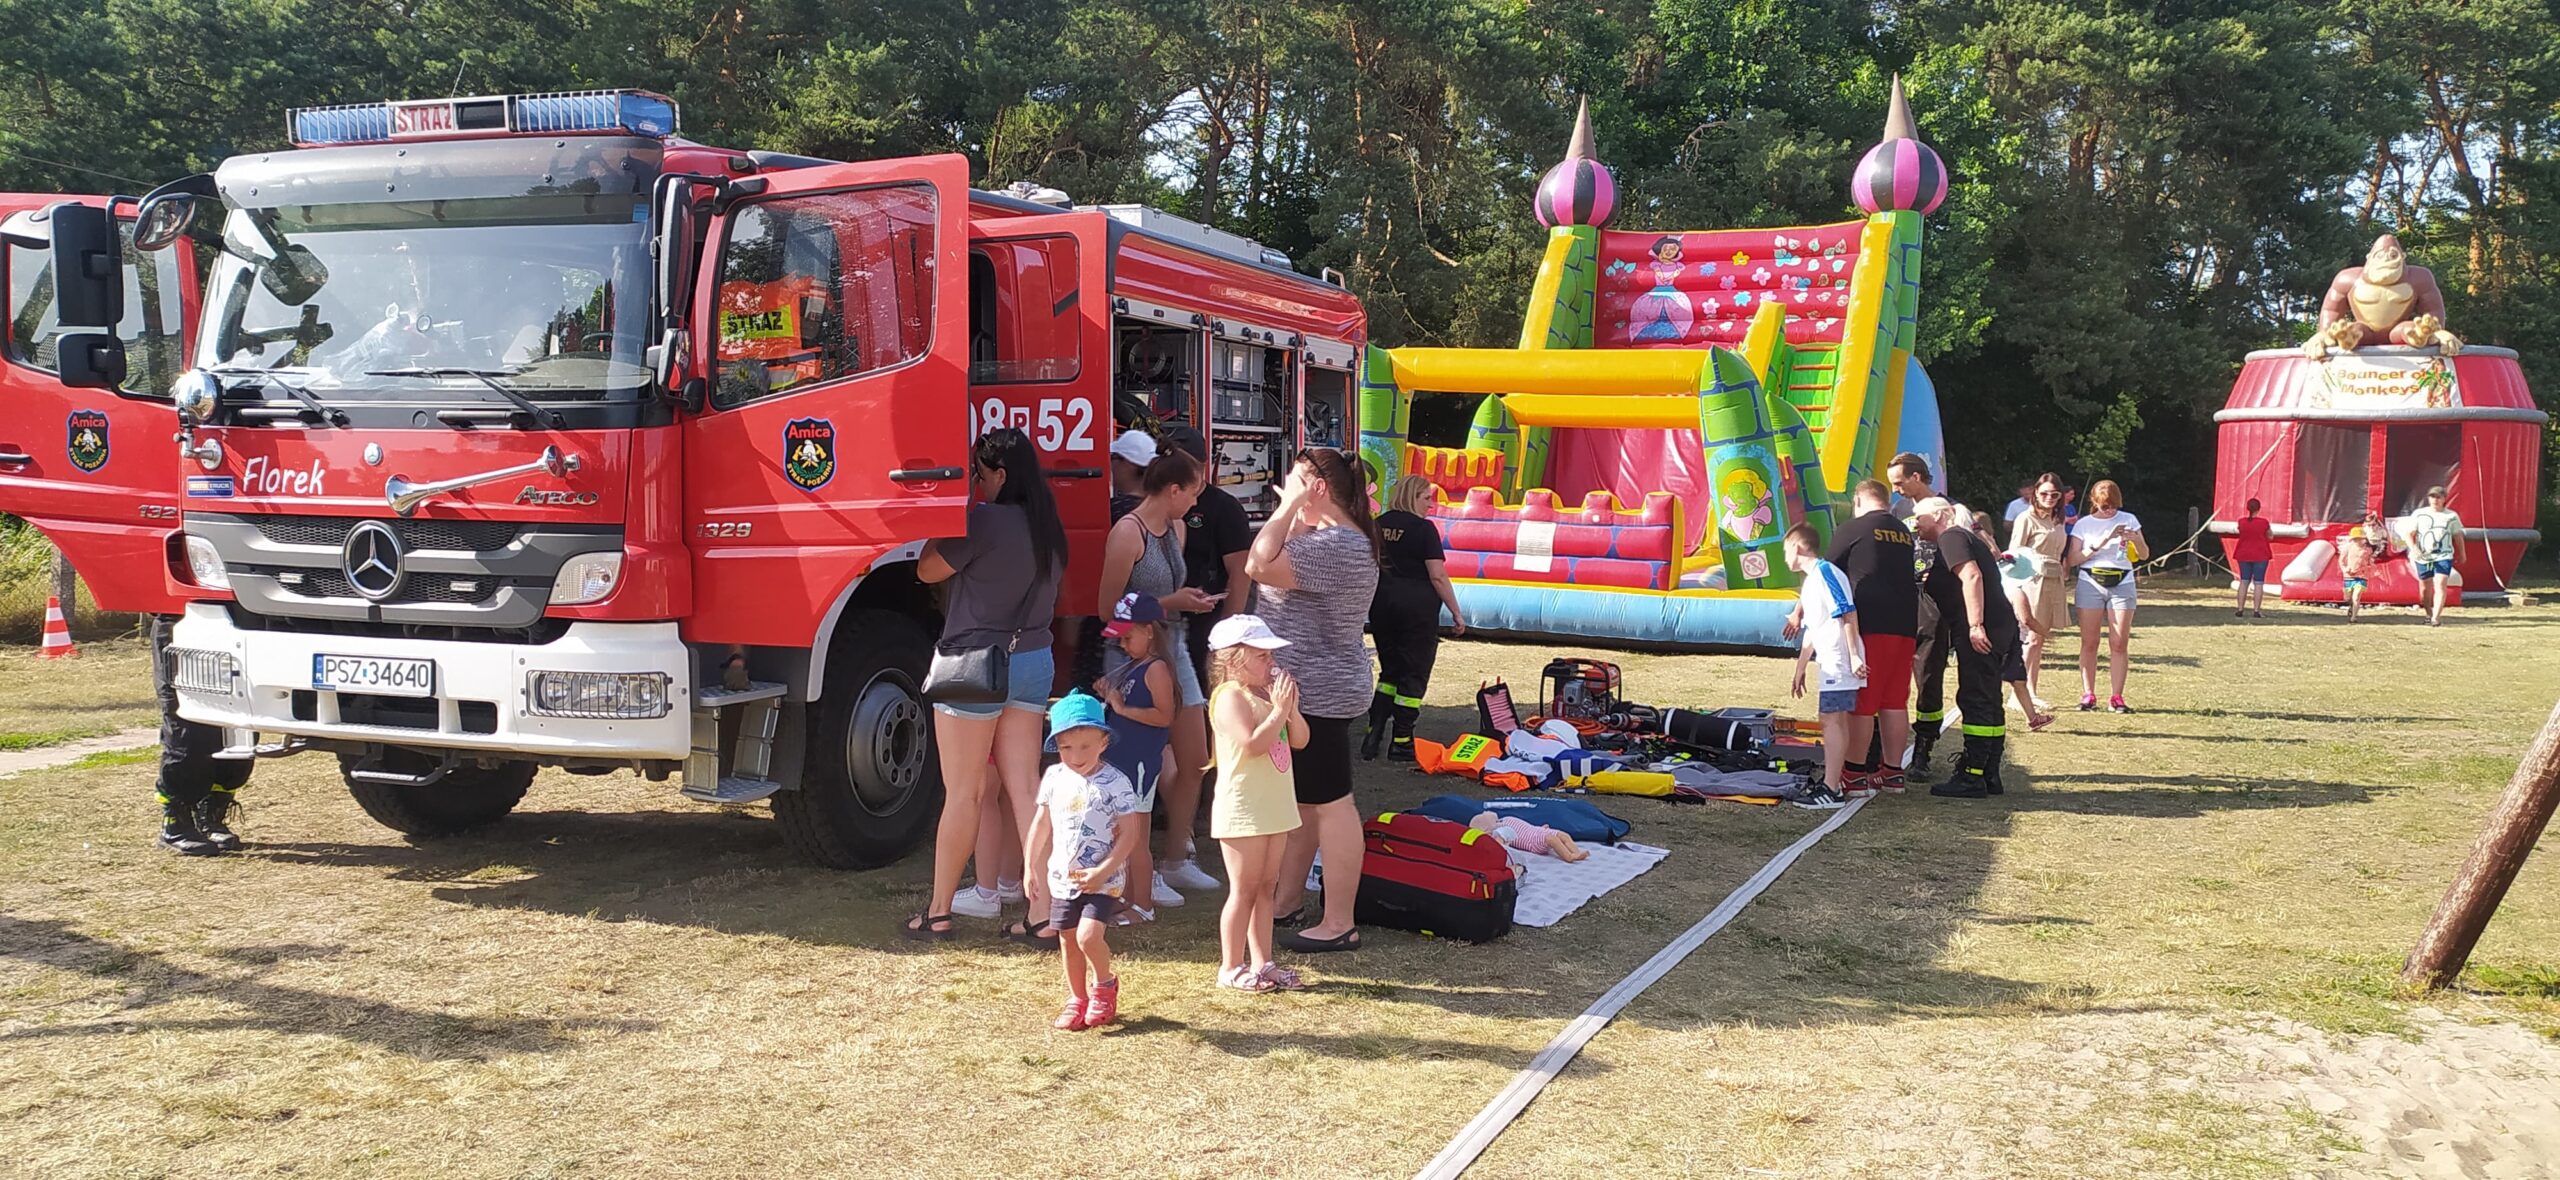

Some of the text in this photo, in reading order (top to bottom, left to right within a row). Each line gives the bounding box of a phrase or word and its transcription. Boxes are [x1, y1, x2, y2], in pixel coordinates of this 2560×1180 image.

[2338, 369, 2407, 381] Bouncer
[2341, 384, 2421, 396] Monkeys
[71, 415, 106, 428] Amica
[788, 423, 831, 439] Amica
[243, 455, 326, 495] Florek
[696, 522, 752, 538] 1329
[325, 659, 430, 688] PSZ 34640
